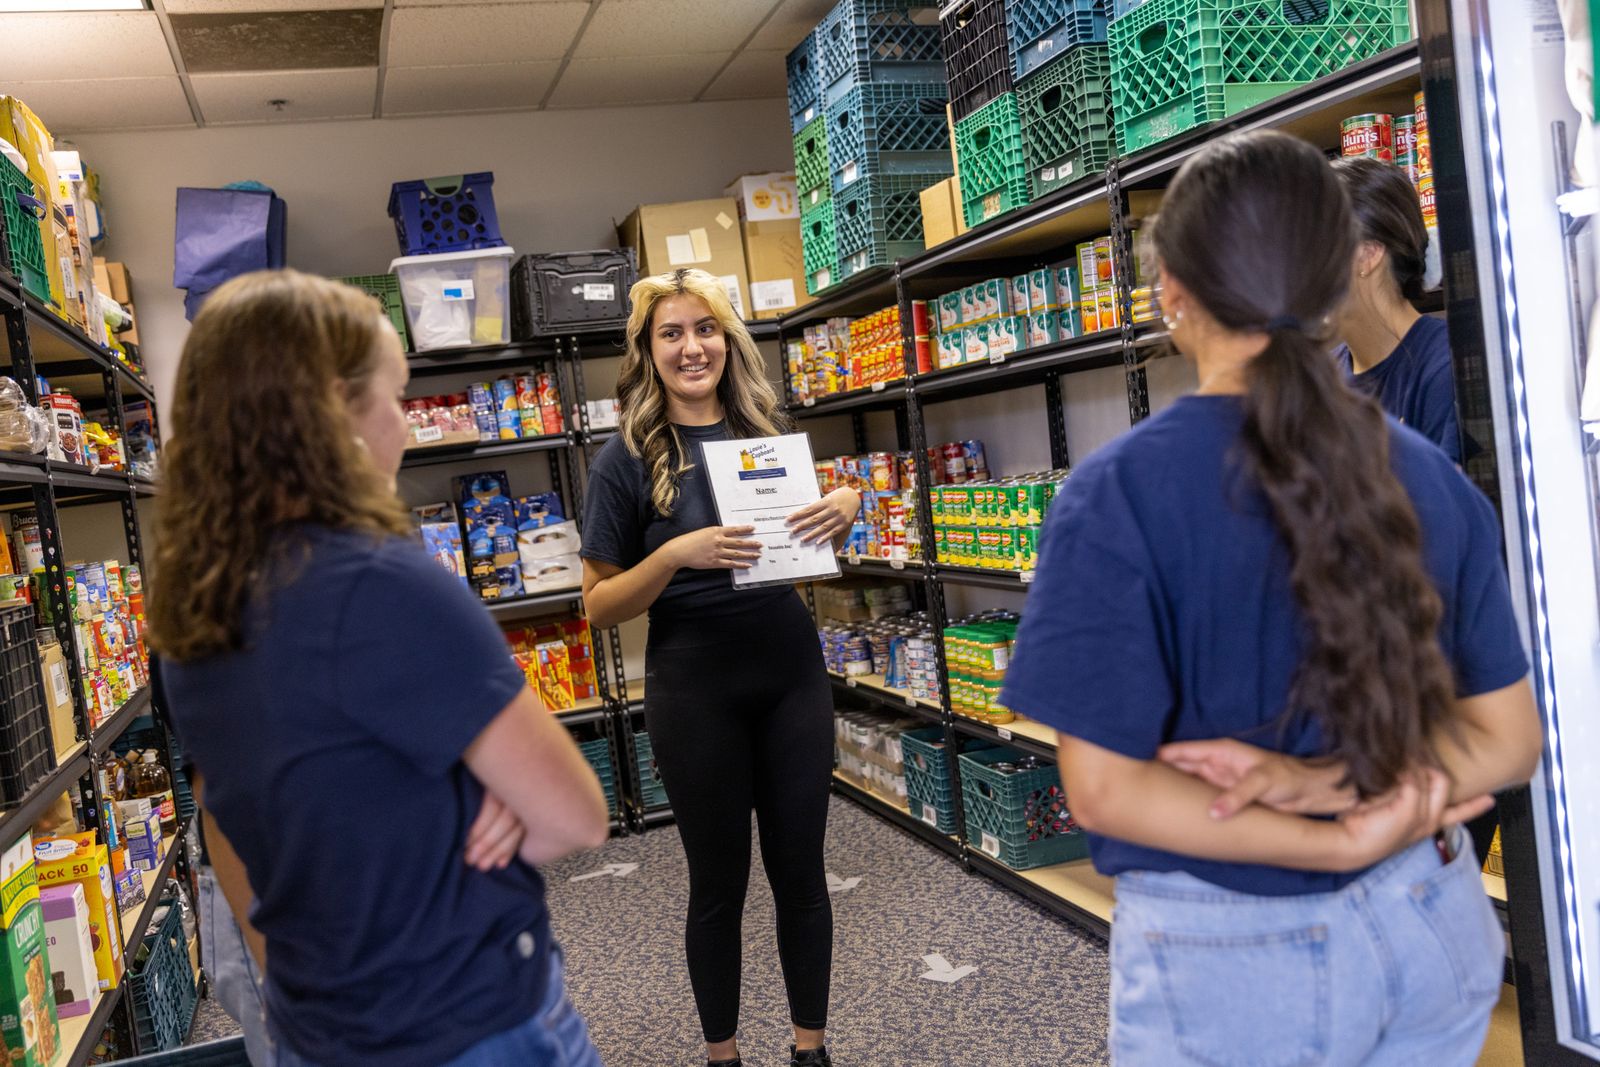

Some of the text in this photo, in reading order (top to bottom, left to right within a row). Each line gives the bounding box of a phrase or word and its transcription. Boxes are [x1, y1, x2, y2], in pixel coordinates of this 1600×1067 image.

[1343, 128, 1378, 147] Hunt's
[1397, 128, 1417, 144] nt's
[38, 863, 89, 882] ACK 50
